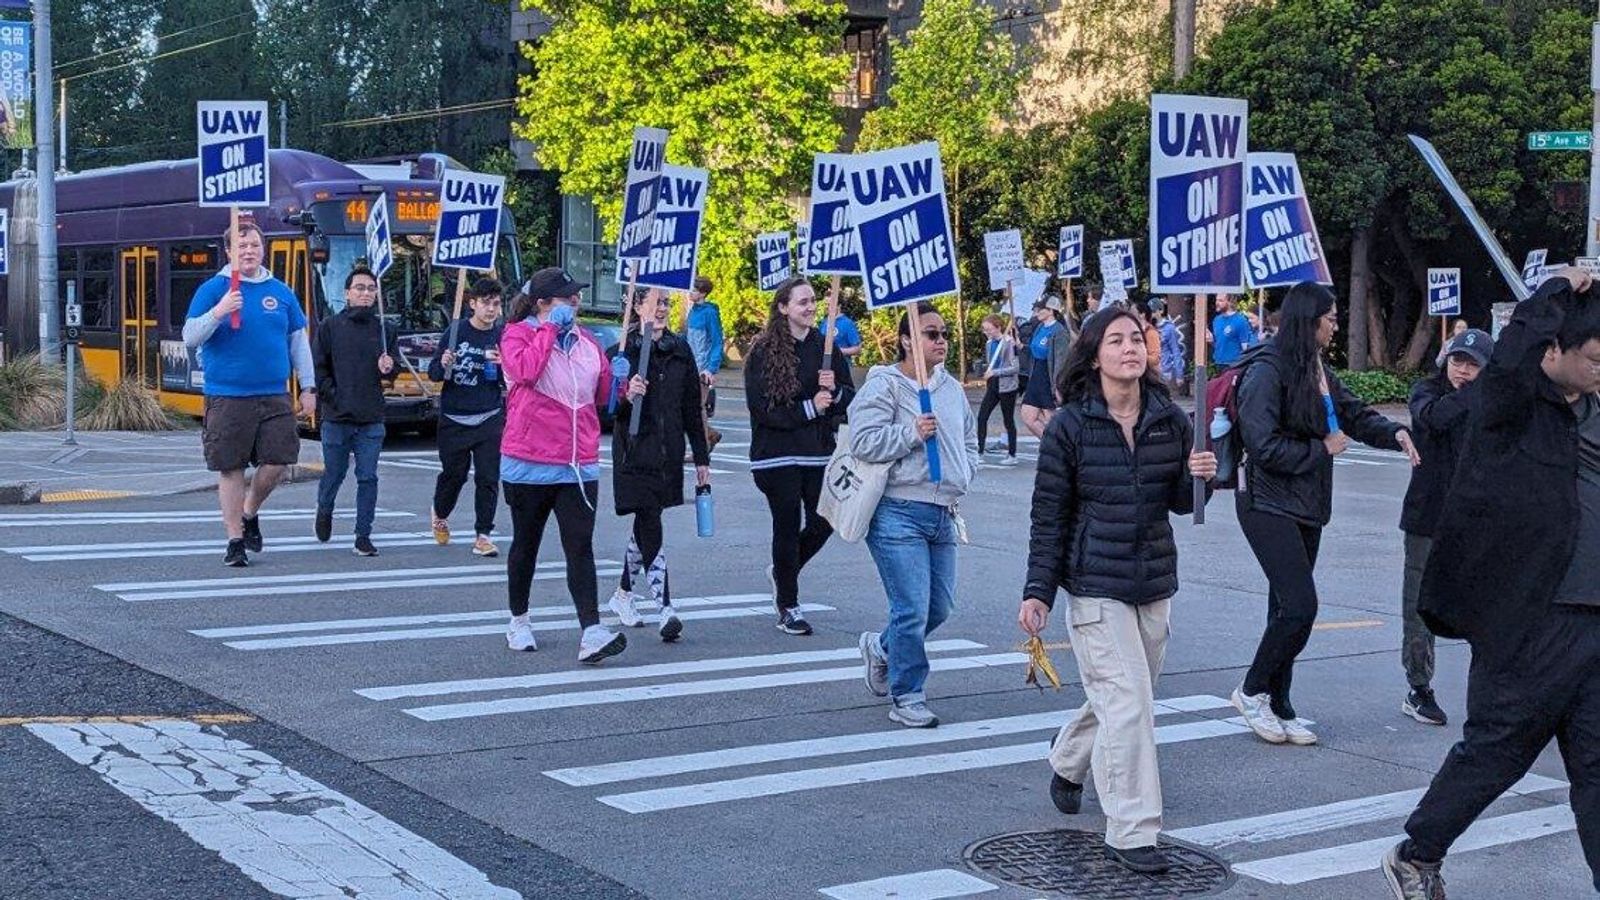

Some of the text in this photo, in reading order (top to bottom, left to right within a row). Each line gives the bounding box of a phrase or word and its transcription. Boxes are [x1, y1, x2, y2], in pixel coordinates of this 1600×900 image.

[13, 27, 24, 46] BE
[1, 26, 12, 90] OF GOOD
[13, 51, 24, 62] A
[201, 110, 262, 134] UAW
[1158, 111, 1241, 160] UAW
[1555, 136, 1570, 145] Ave
[1575, 135, 1588, 145] NE
[222, 143, 245, 168] ON
[205, 163, 263, 199] STRIKE
[659, 175, 702, 208] AW
[818, 163, 847, 193] UA
[851, 158, 933, 206] UAW
[1251, 165, 1295, 196] AW
[446, 180, 500, 206] UAW
[1187, 176, 1219, 224] ON
[346, 200, 368, 223] 44
[458, 213, 480, 236] ON
[1261, 206, 1292, 240] ON
[651, 217, 677, 246] ON
[760, 237, 788, 253] UAW
[888, 210, 921, 252] ON
[438, 232, 493, 261] STRIKE
[810, 232, 857, 266] STRI
[1161, 213, 1240, 279] STRIKE
[1250, 232, 1319, 280] STRIKE
[871, 234, 948, 300] STRIKE
[1430, 273, 1457, 284] UAW
[457, 341, 484, 357] Gen
[454, 372, 478, 386] Club
